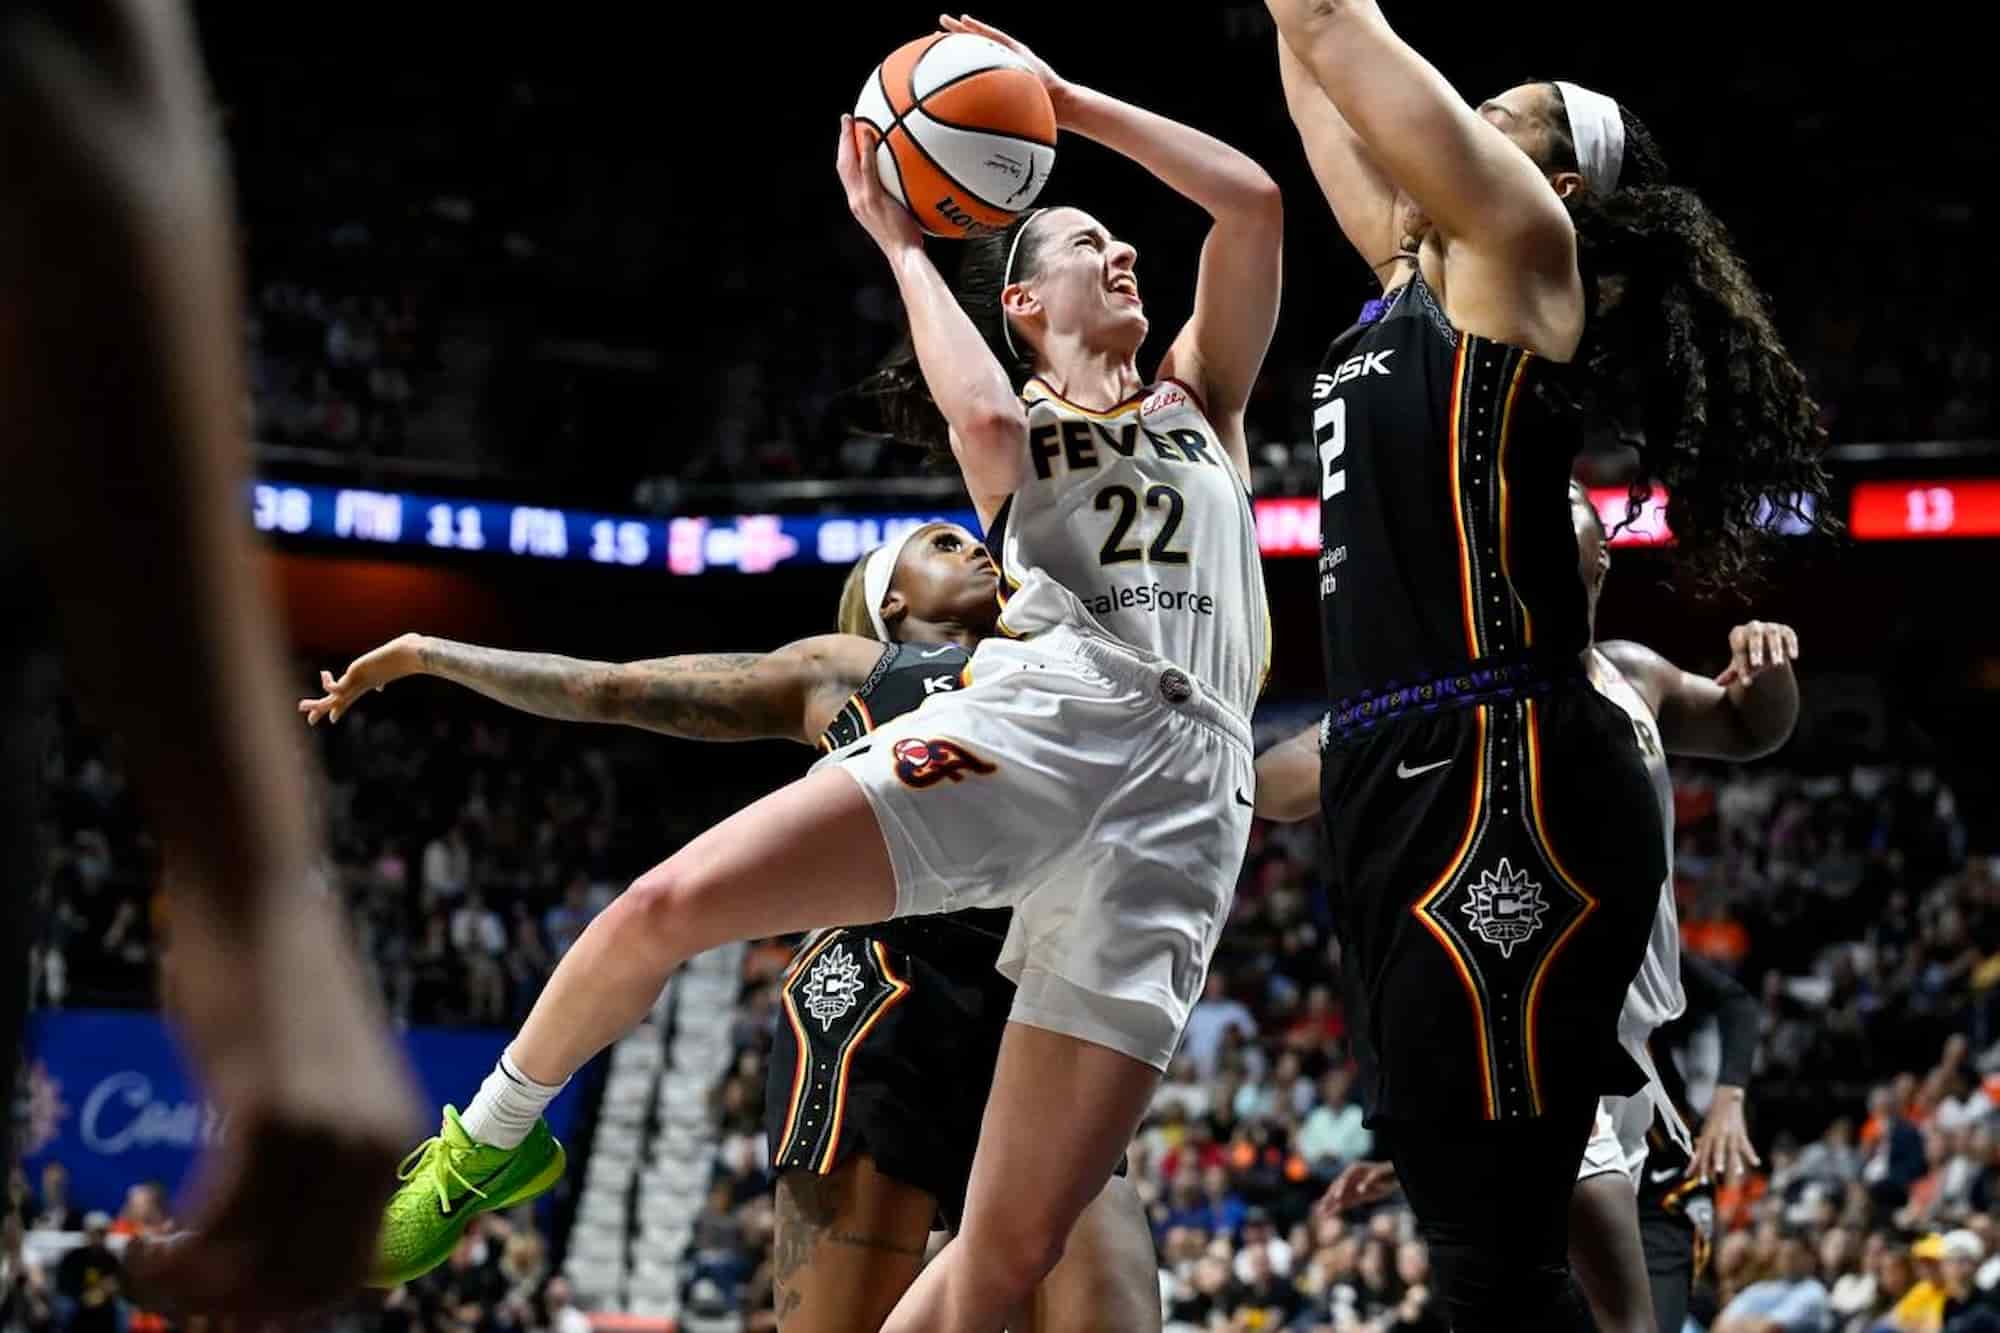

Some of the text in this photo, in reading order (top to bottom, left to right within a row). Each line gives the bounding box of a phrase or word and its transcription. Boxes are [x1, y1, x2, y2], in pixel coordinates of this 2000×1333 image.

[1030, 421, 1219, 480] FEVER
[1313, 397, 1346, 500] 2
[426, 503, 485, 551] 11
[590, 519, 649, 566] 15
[1094, 485, 1189, 566] 22
[1085, 582, 1213, 615] salesforce
